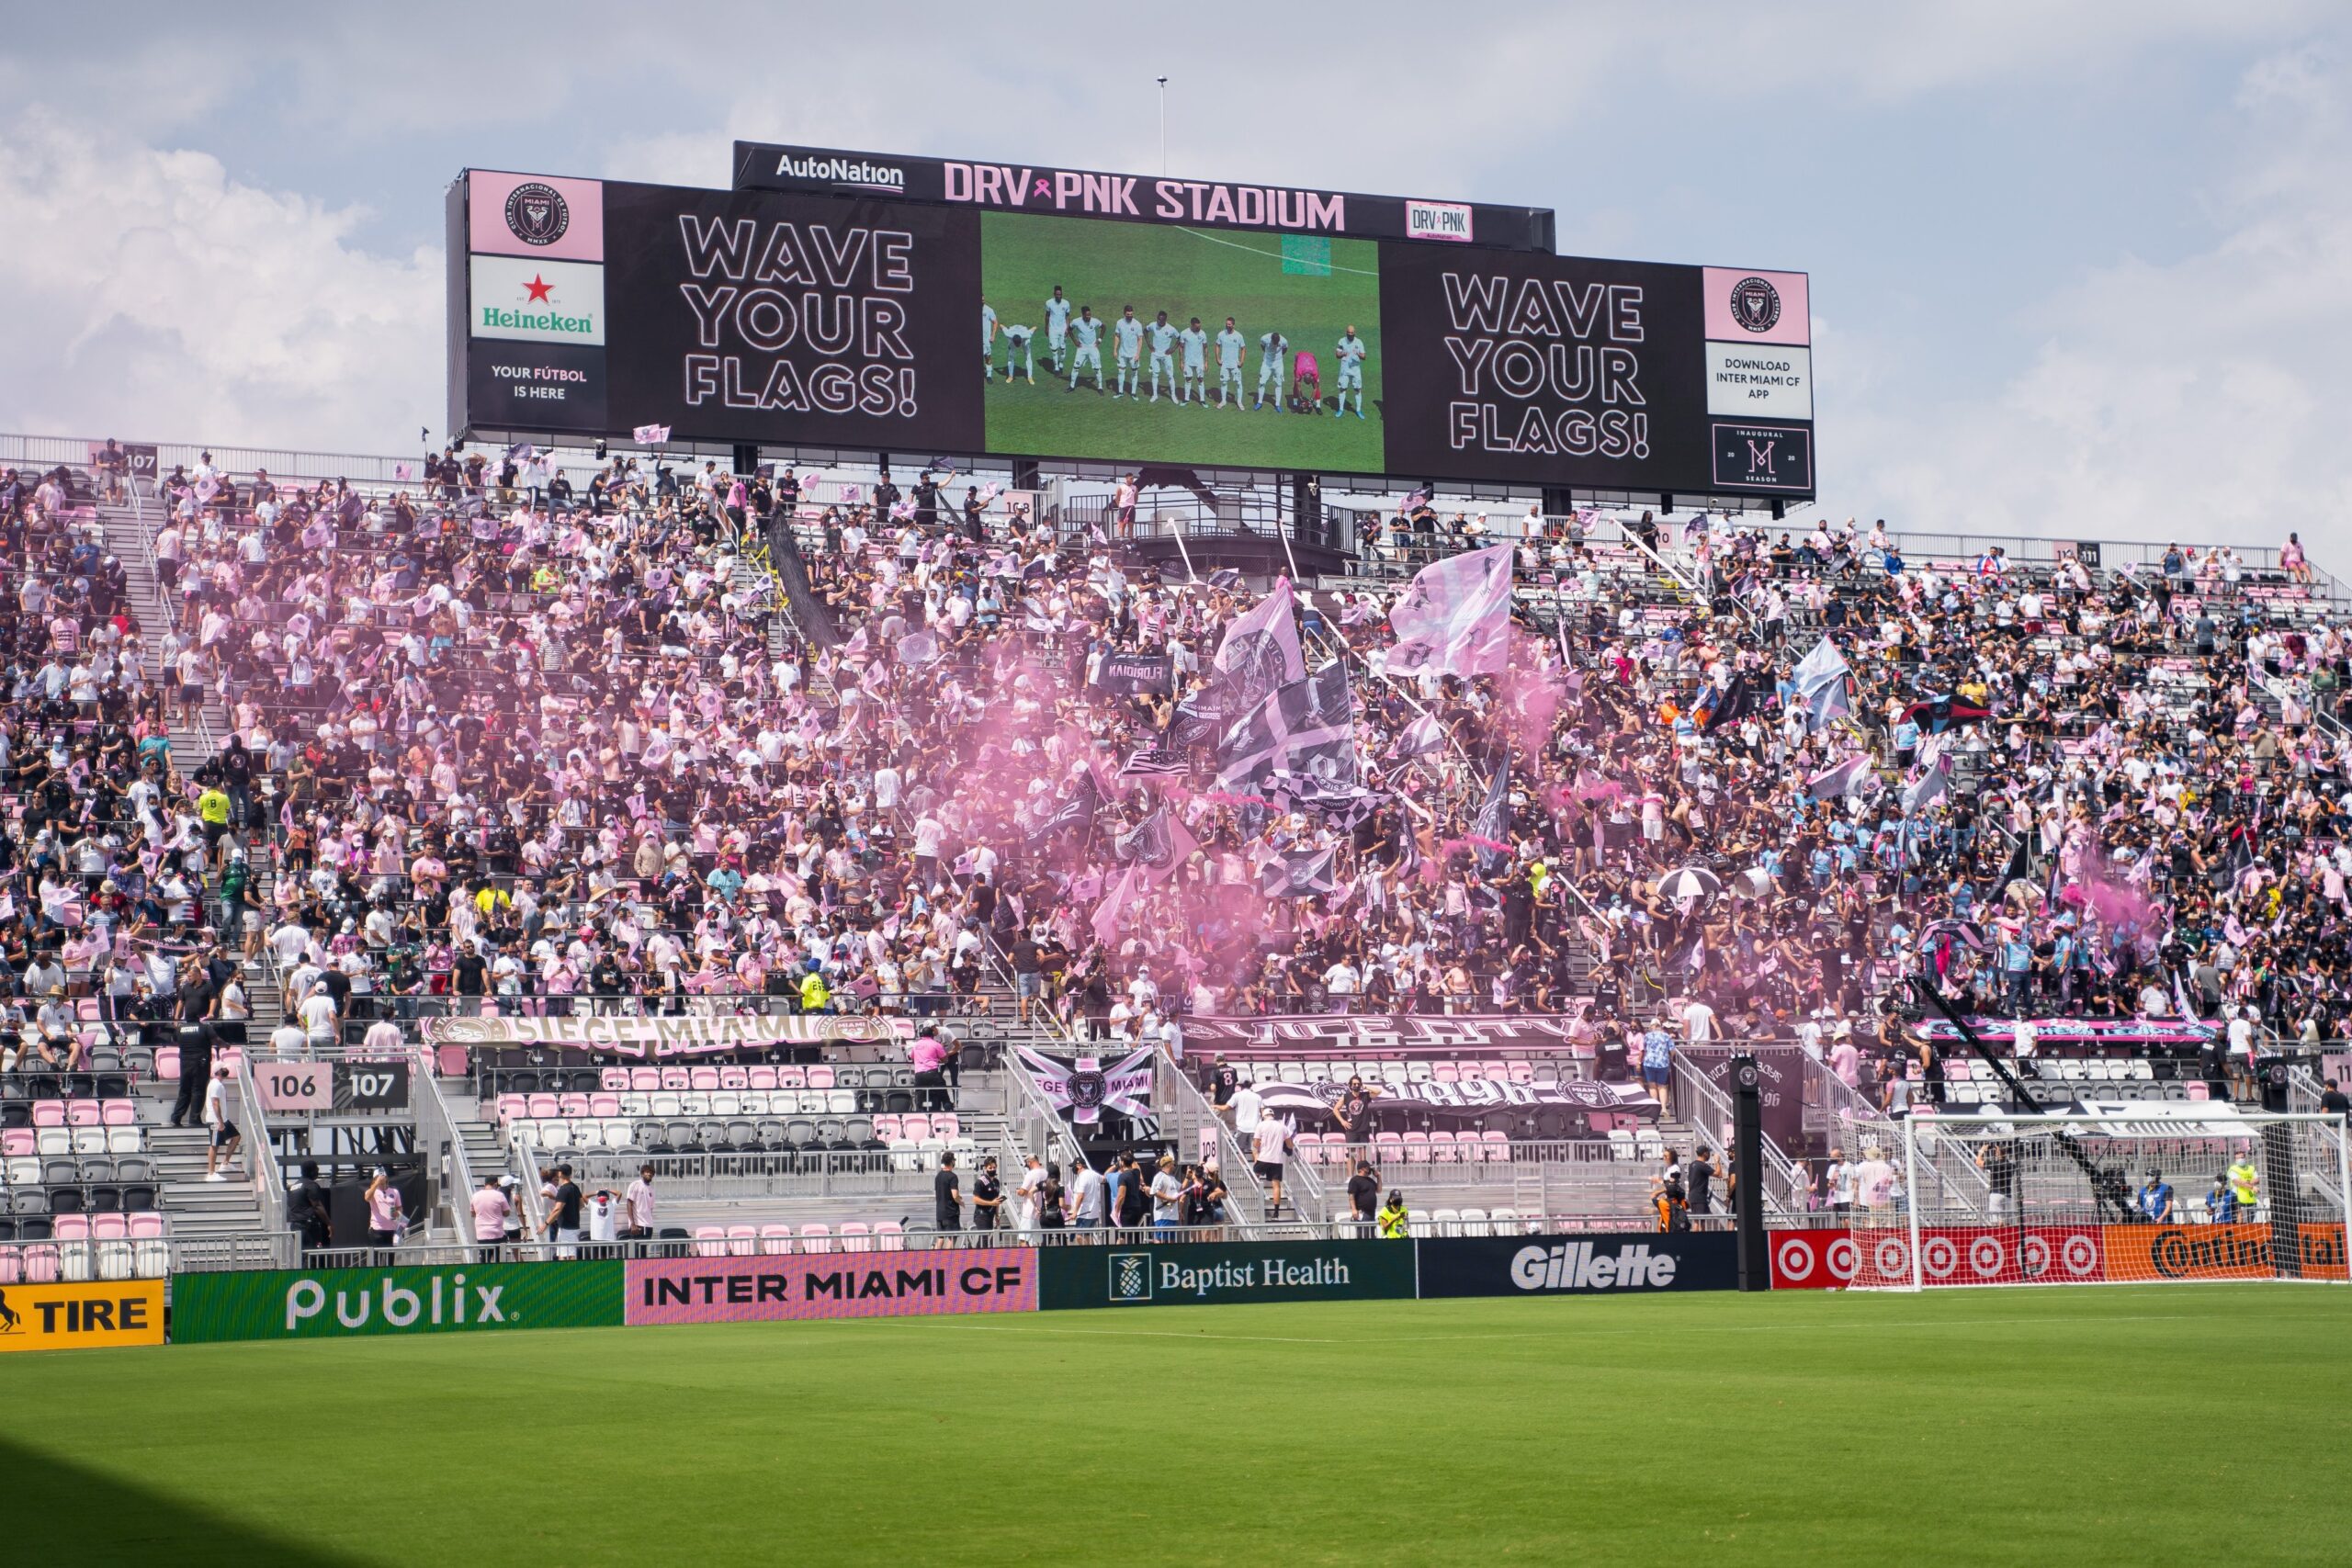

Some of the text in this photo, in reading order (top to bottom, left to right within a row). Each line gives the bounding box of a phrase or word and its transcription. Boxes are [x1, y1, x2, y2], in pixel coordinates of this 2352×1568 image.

[776, 154, 904, 186] AutoNation
[944, 163, 1345, 231] DRV PNK STADIUM
[1413, 209, 1465, 232] DRV PNK
[678, 215, 912, 292] WAVE
[1442, 273, 1645, 342] WAVE
[482, 307, 593, 333] Heineken
[680, 284, 914, 360] YOUR
[492, 366, 587, 382] YOUR FÚTBOL
[1444, 336, 1646, 405] YOUR
[1725, 358, 1790, 371] DOWNLOAD
[684, 354, 918, 418] FLAGS!
[1716, 373, 1801, 387] INTER MIAMI CF
[514, 386, 565, 400] IS HERE
[1748, 389, 1770, 399] APP
[1450, 402, 1650, 458] FLAGS!
[1736, 430, 1783, 438] INAUGURAL
[126, 455, 155, 468] 107
[679, 484, 695, 496] 10
[1657, 533, 1669, 543] 10
[653, 1016, 814, 1051] MIAMI
[348, 1074, 395, 1097] 107
[1111, 1076, 1148, 1092] MIAMI
[1223, 1072, 1233, 1086] 8
[2337, 1065, 2352, 1083] 11
[270, 1075, 316, 1098] 106
[1203, 1141, 1216, 1158] 108
[1510, 1241, 1677, 1290] Gillette
[2151, 1230, 2347, 1278] Continetal
[645, 1267, 1021, 1306] INTER MIAMI CF
[1159, 1258, 1351, 1296] Baptist Health
[286, 1273, 505, 1330] Publix
[33, 1297, 149, 1333] TIRE
